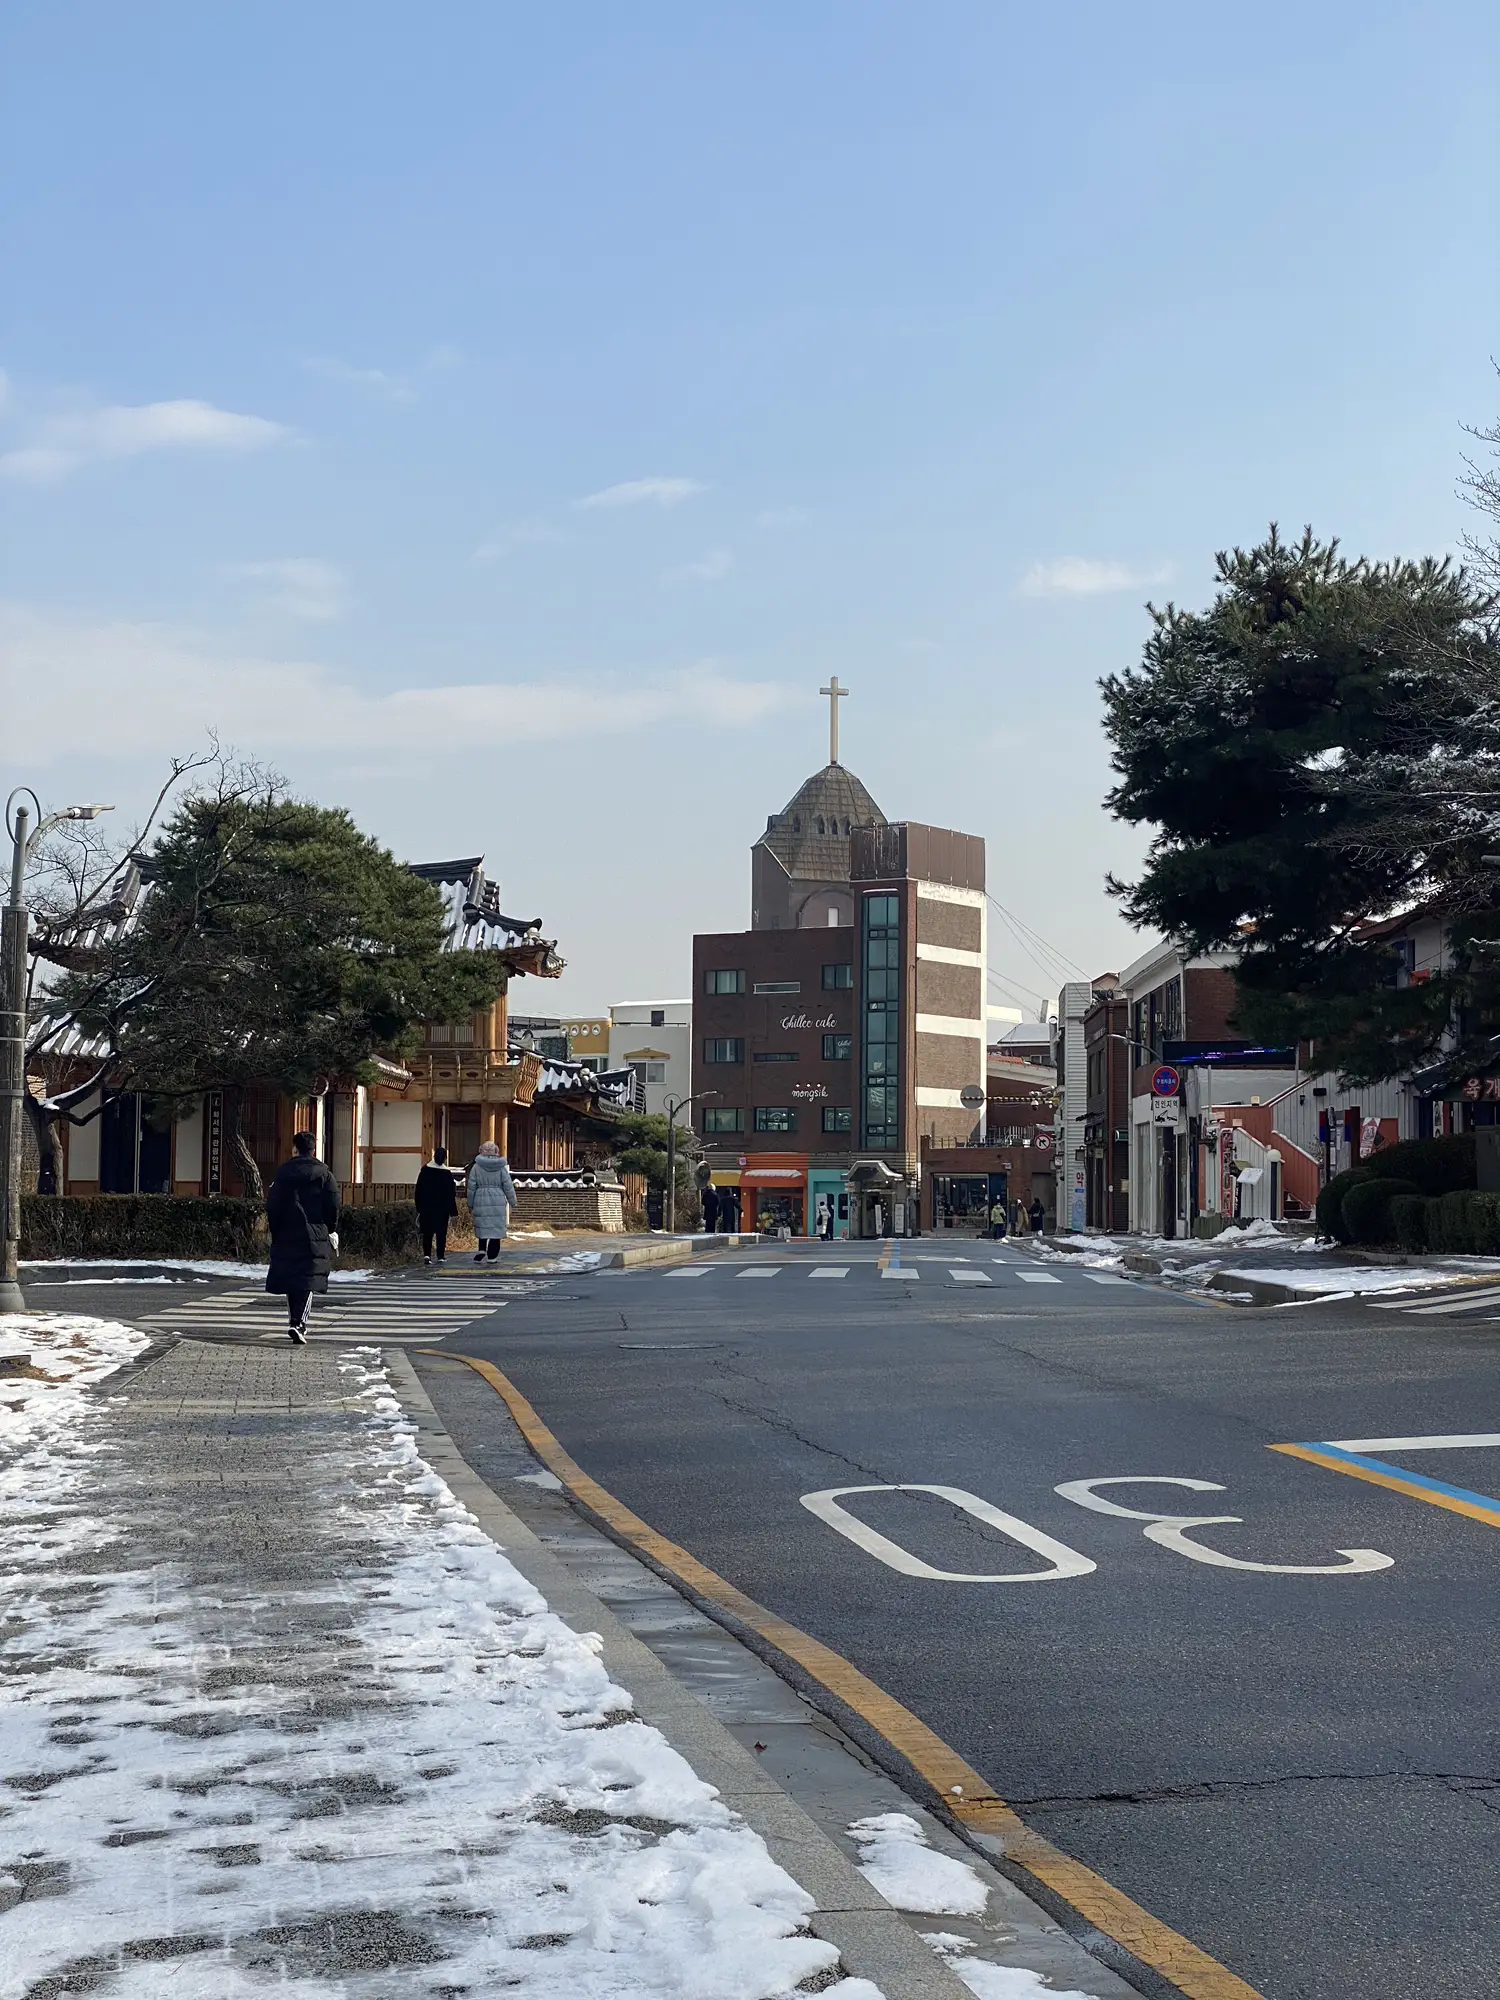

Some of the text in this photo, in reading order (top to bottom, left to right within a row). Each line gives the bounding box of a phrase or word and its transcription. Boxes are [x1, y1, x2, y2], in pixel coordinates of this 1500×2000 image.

[791, 1086, 828, 1102] mongsik
[1155, 1100, 1178, 1109] 견인지역
[211, 1111, 220, 1180] 화서문 관광안내소
[800, 1476, 1395, 1583] 30
